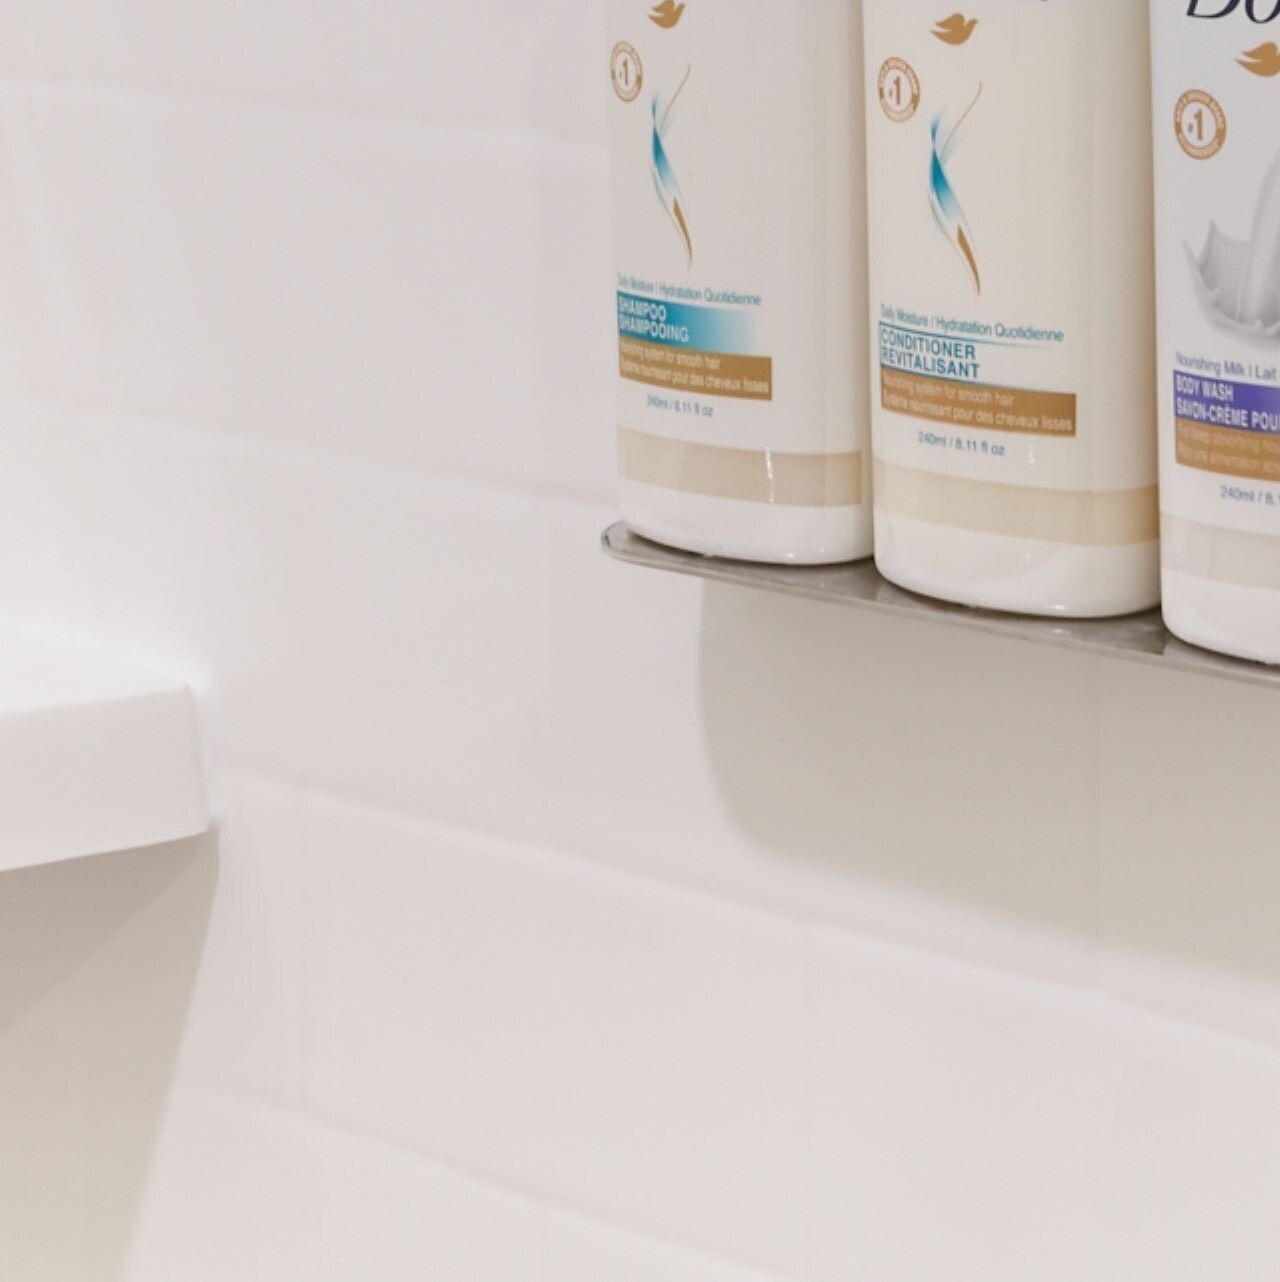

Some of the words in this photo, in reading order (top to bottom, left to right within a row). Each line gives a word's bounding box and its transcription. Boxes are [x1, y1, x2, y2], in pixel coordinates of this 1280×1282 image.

[618, 295, 667, 321] SHAMPOO
[704, 288, 762, 306] Quotidienne
[619, 313, 690, 342] SHAMPOOING
[936, 316, 993, 337] Hydratation
[994, 322, 1065, 343] Quotidienne
[881, 328, 977, 360] CONDITIONER
[882, 345, 980, 379] REVITALISANT
[1223, 360, 1246, 377] Milk
[1254, 364, 1278, 381] Lait
[705, 375, 742, 391] cheveux
[742, 376, 770, 394] lisses
[959, 387, 993, 405] smooth
[995, 391, 1015, 408] hair
[1176, 374, 1201, 394] BODY
[1202, 379, 1235, 402] WASH
[701, 405, 715, 417] oz
[952, 405, 975, 422] pour
[975, 407, 994, 424] des
[995, 411, 1040, 428] cheveux
[1041, 415, 1073, 431] lisses
[1176, 397, 1249, 429] SAVON-CRÈME
[918, 431, 947, 448] 240ml
[955, 438, 977, 453] 8.11
[981, 440, 989, 453] fl
[991, 444, 1006, 456] oz
[1220, 485, 1256, 503] 240ml
